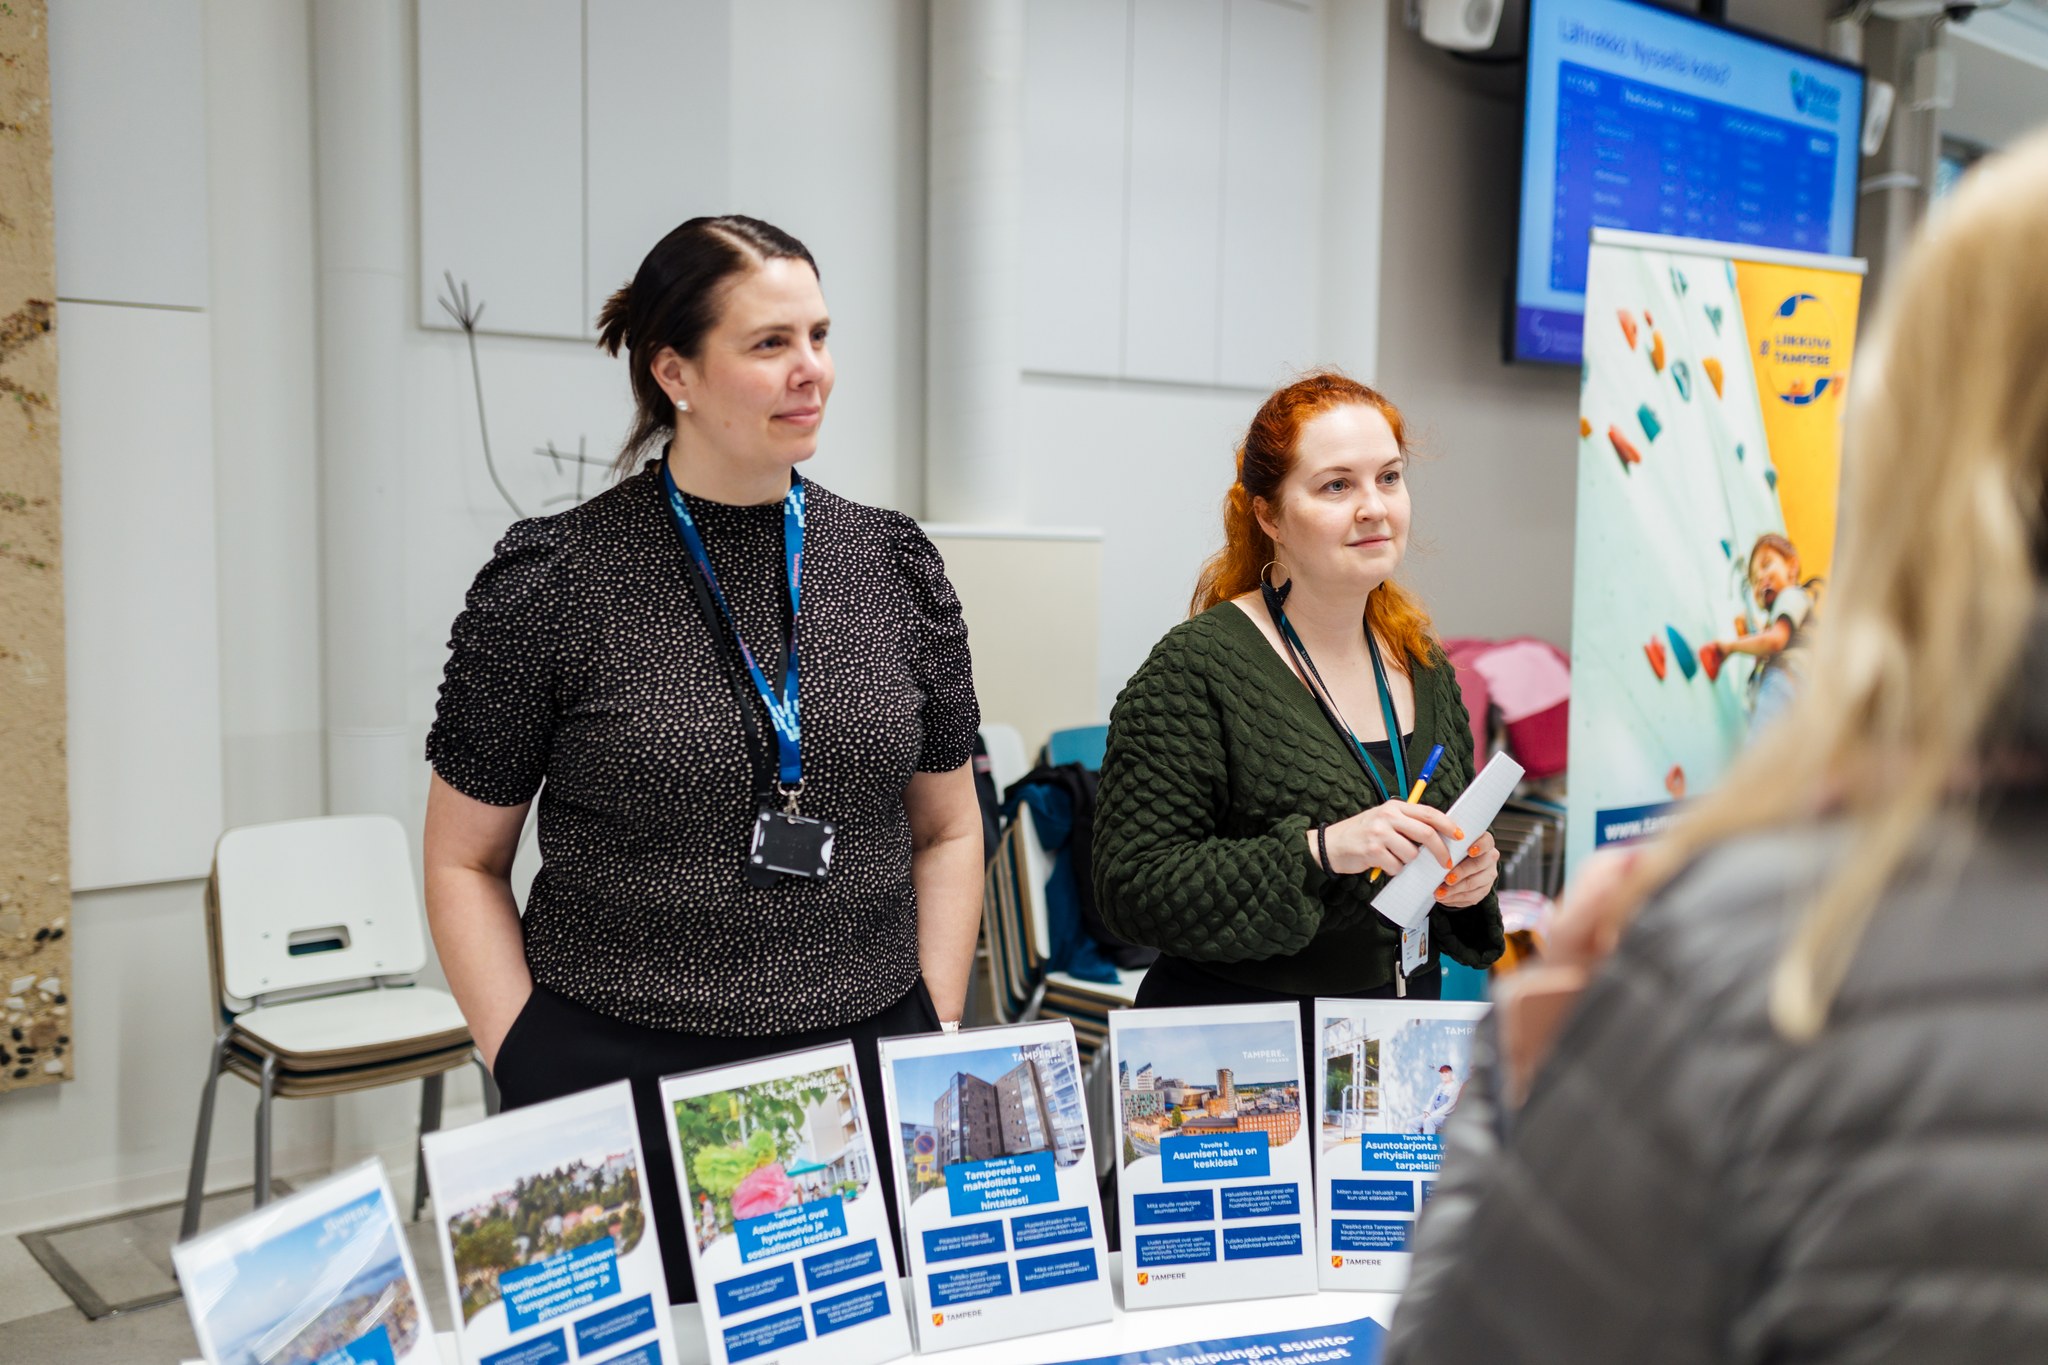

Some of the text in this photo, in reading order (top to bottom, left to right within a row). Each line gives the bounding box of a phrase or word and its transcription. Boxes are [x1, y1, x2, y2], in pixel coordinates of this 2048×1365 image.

[1776, 351, 1831, 367] TAMPERE
[1444, 1026, 1476, 1035] TAMP
[1365, 1141, 1437, 1151] Asuntotarjonta
[1173, 1149, 1218, 1160] Asumisen
[1220, 1149, 1243, 1157] laatu
[1373, 1151, 1414, 1161] erityisiin
[1194, 1158, 1238, 1168] keskiössä
[1396, 1162, 1441, 1171] tarpeisiin
[965, 1164, 1036, 1181] Tampereella on
[963, 1173, 1041, 1192] mahdollista asua
[985, 1187, 1021, 1199] kohtuu-
[981, 1195, 1029, 1210] hintaisesti
[752, 1208, 829, 1236] Asuinalueet ovat
[761, 1221, 823, 1246] hyvinvoivia ja
[516, 1288, 573, 1316] Tampereen
[600, 1275, 610, 1287] ja
[947, 1310, 982, 1321] TAMPERE
[1166, 1336, 1354, 1365] kaupungin asunto-
